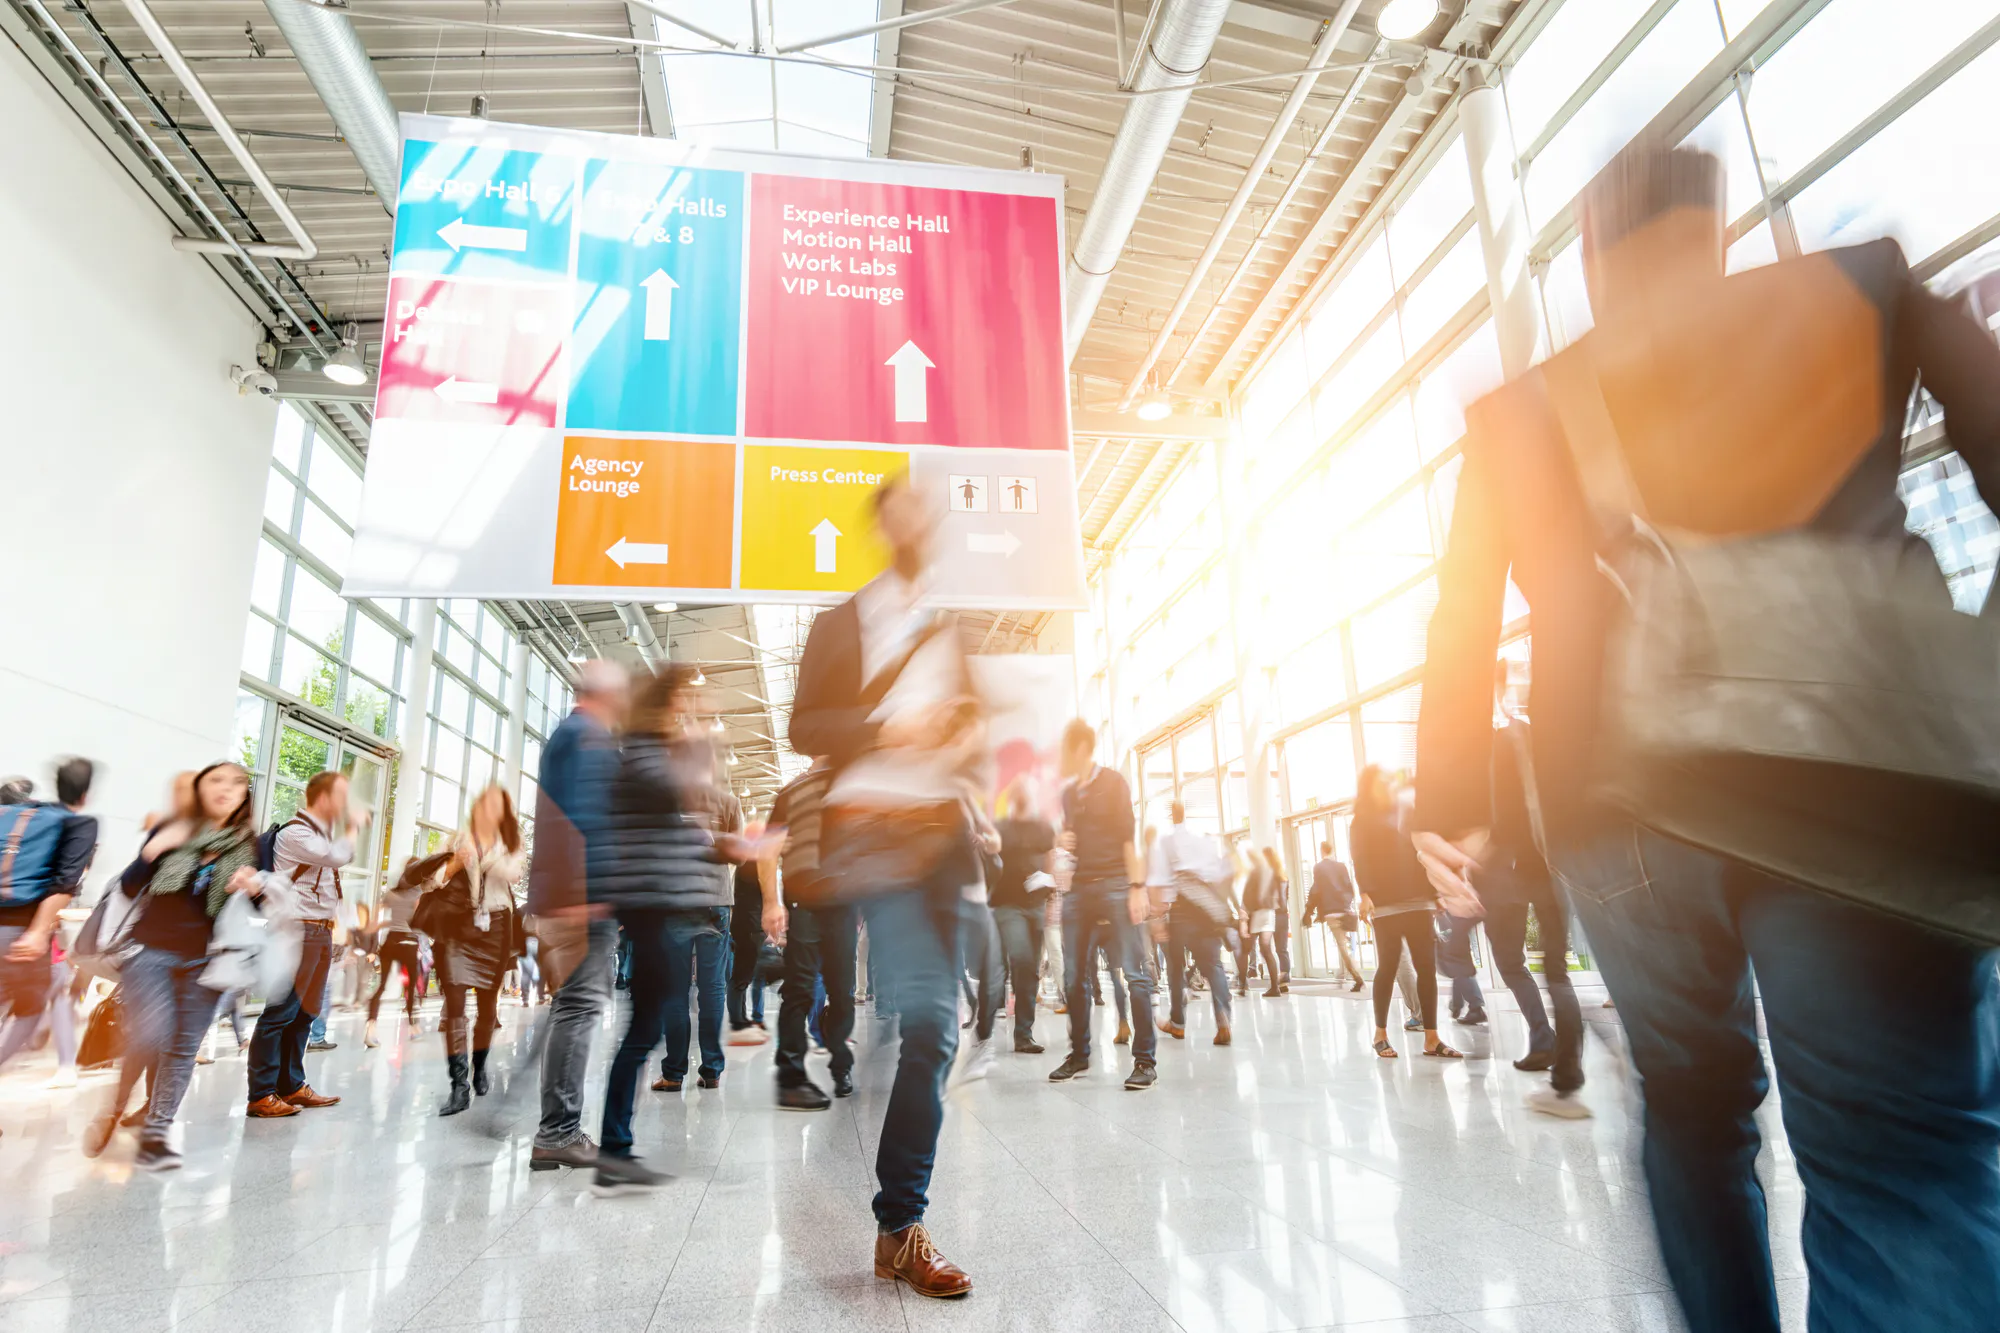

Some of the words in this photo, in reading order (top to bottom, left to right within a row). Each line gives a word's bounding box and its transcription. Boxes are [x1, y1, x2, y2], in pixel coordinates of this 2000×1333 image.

[486, 180, 538, 202] Hall
[667, 196, 727, 218] Halls
[783, 204, 900, 229] Experience
[906, 213, 950, 233] Hall
[653, 227, 672, 243] &
[678, 226, 694, 244] 8
[783, 228, 862, 251] Motion
[868, 235, 912, 254] Hall
[781, 251, 842, 273] Work
[849, 257, 897, 276] Labs
[781, 276, 819, 296] VIP
[826, 279, 904, 306] Lounge
[569, 454, 644, 478] Agency
[770, 466, 818, 483] Press
[822, 468, 885, 486] Center
[568, 475, 641, 498] Lounge
